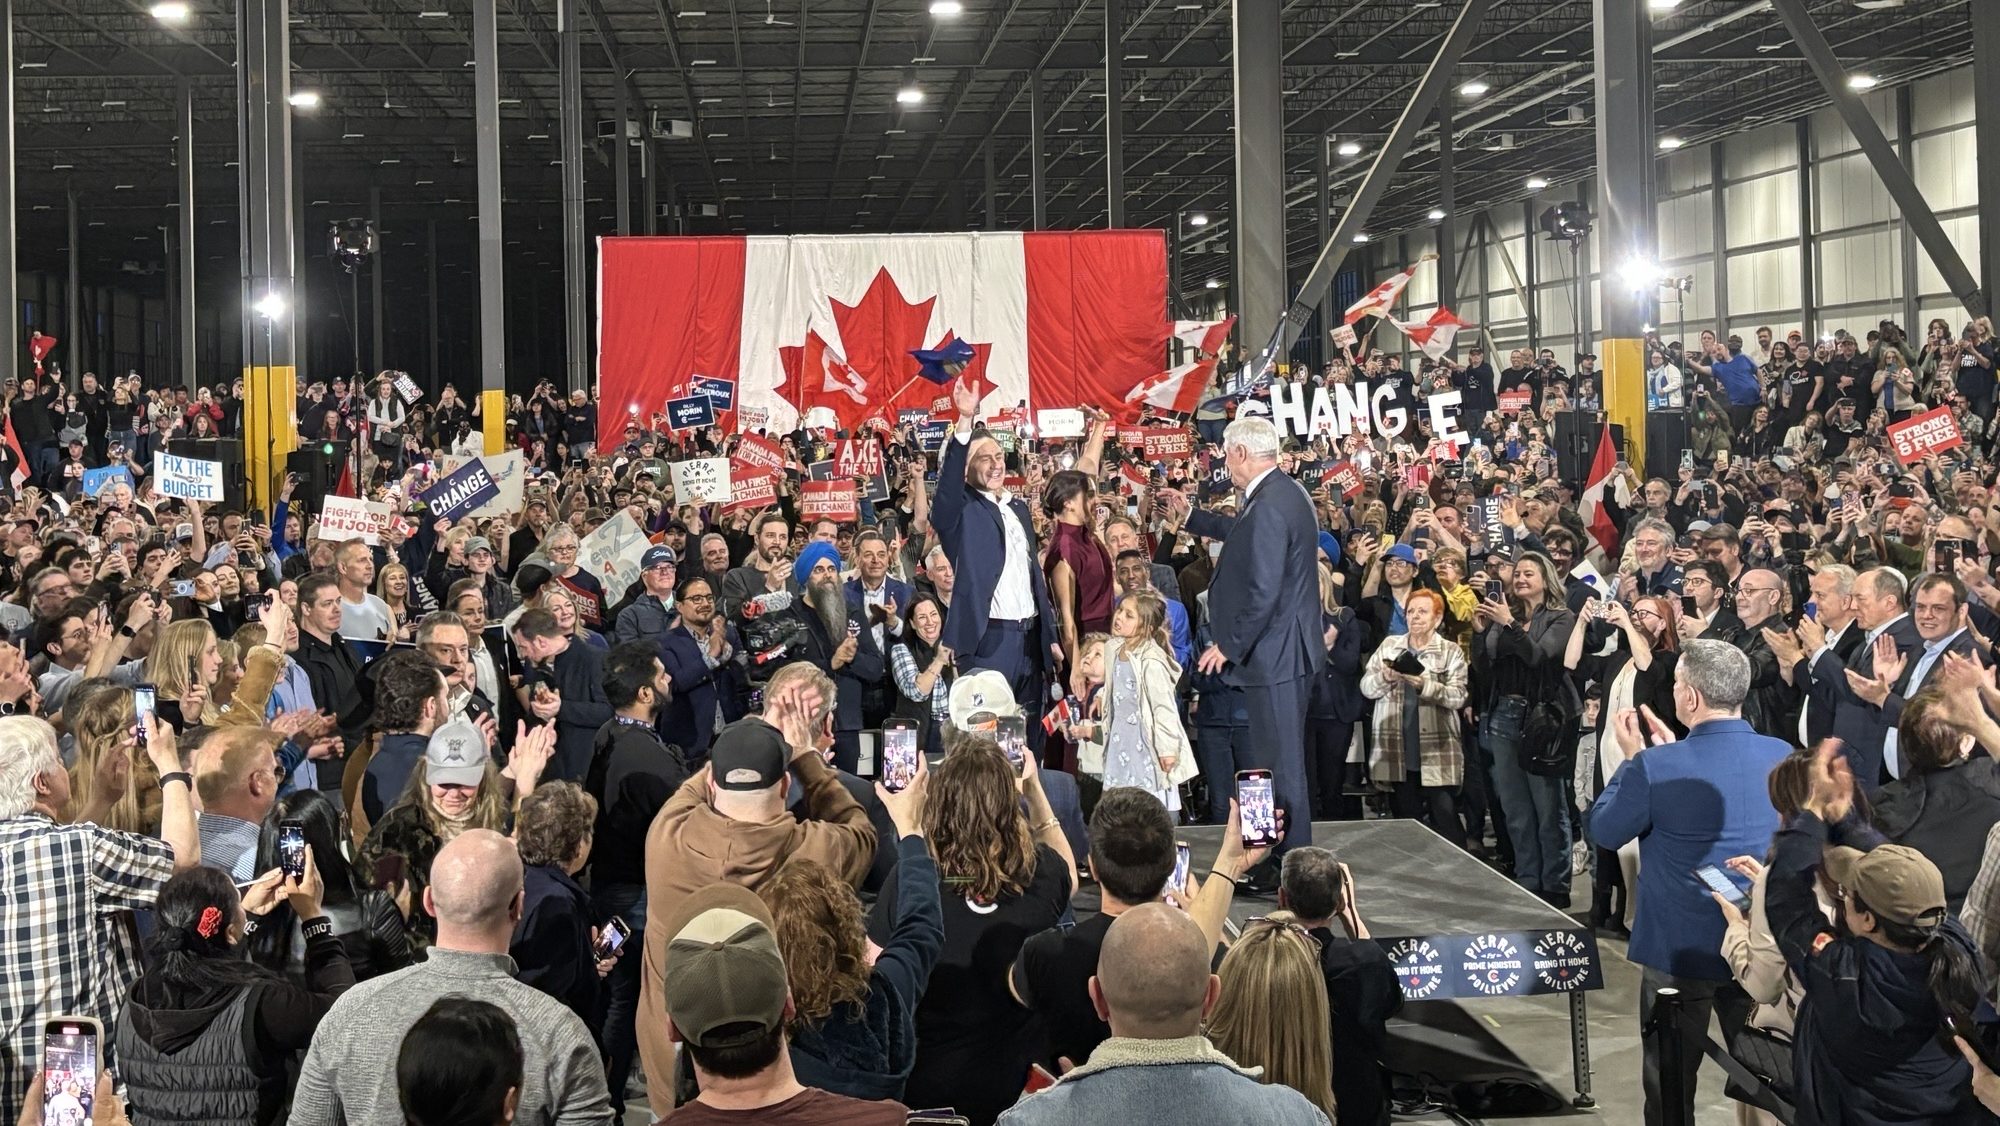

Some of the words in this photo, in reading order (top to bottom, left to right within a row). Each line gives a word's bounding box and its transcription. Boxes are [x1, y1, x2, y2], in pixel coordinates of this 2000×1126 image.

[1145, 433, 1187, 445] STRONG
[1893, 414, 1951, 443] STRONG
[839, 438, 878, 464] AXE
[1157, 442, 1188, 455] FREE
[1898, 441, 1913, 456] &
[1911, 425, 1958, 452] FREE
[163, 455, 183, 473] FIX
[187, 460, 213, 477] THE
[682, 460, 715, 478] PIERRE
[839, 463, 860, 476] THE
[861, 463, 878, 475] TAX
[163, 478, 213, 498] BUDGET
[430, 468, 489, 517] CHANGE
[731, 480, 748, 492] ADA
[747, 474, 771, 488] FIRST
[740, 486, 772, 500] CHANGE
[803, 491, 830, 501] CANADA
[830, 490, 854, 501] FIRST
[364, 512, 387, 523] FOR
[820, 502, 853, 512] CHANGE
[1485, 498, 1502, 549] HANGE
[412, 576, 440, 616] ANGE
[1387, 938, 1439, 964] PIERRE
[1464, 934, 1518, 960] PIERRE
[1534, 931, 1586, 956] PIERRE
[1394, 968, 1410, 976] ING
[1410, 966, 1419, 975] IT
[1420, 965, 1443, 975] HOME
[1463, 961, 1486, 970] PRIME
[1487, 960, 1522, 970] MINISTER
[1534, 959, 1558, 969] BRING
[1559, 957, 1567, 967] IT
[1567, 956, 1590, 966] HOME
[1400, 976, 1442, 999] ILIEVRE
[1467, 971, 1520, 995] POILIEVRE
[1538, 967, 1589, 991] POILIEVRE
